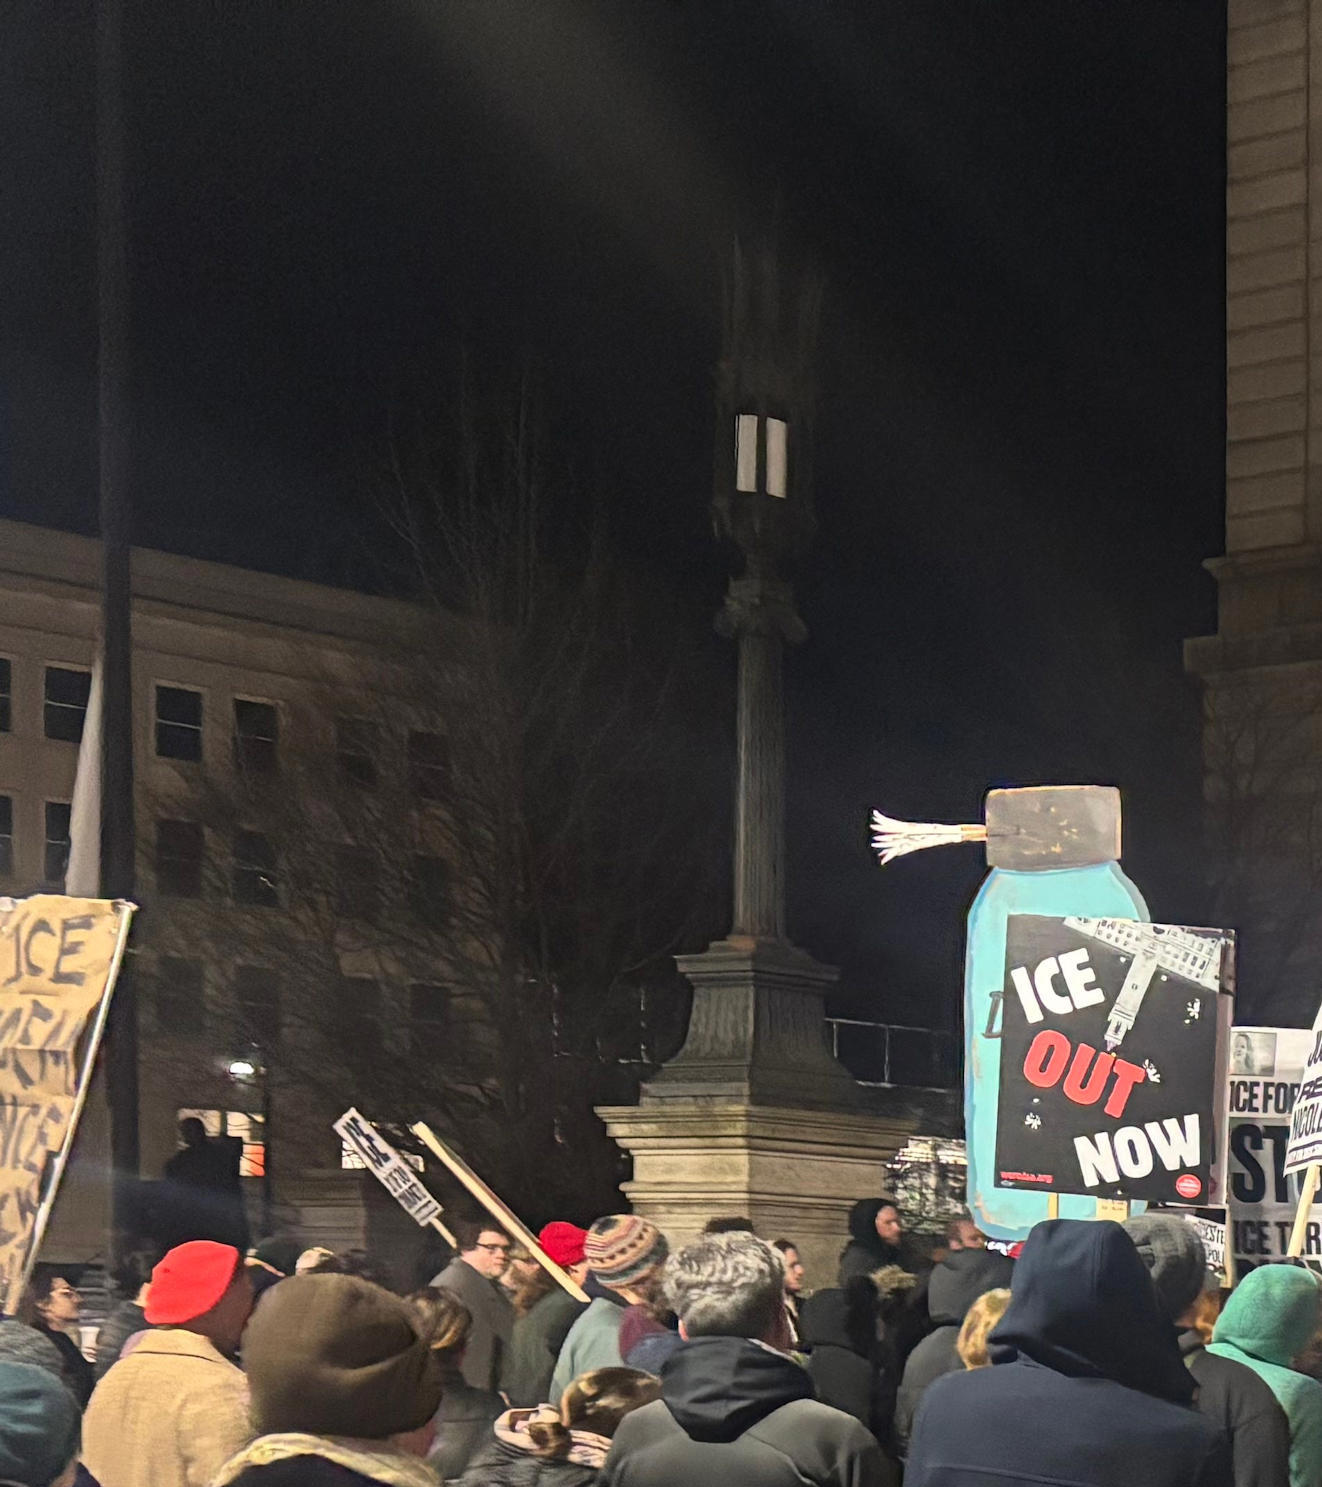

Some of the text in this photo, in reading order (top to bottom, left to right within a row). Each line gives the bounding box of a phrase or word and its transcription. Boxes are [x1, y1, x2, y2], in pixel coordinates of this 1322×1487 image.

[2, 912, 96, 987] ICE
[1010, 947, 1105, 1024] ICE
[1023, 1029, 1147, 1119] OUT
[1073, 1113, 1201, 1188] NOW
[1232, 1220, 1273, 1254] ICE
